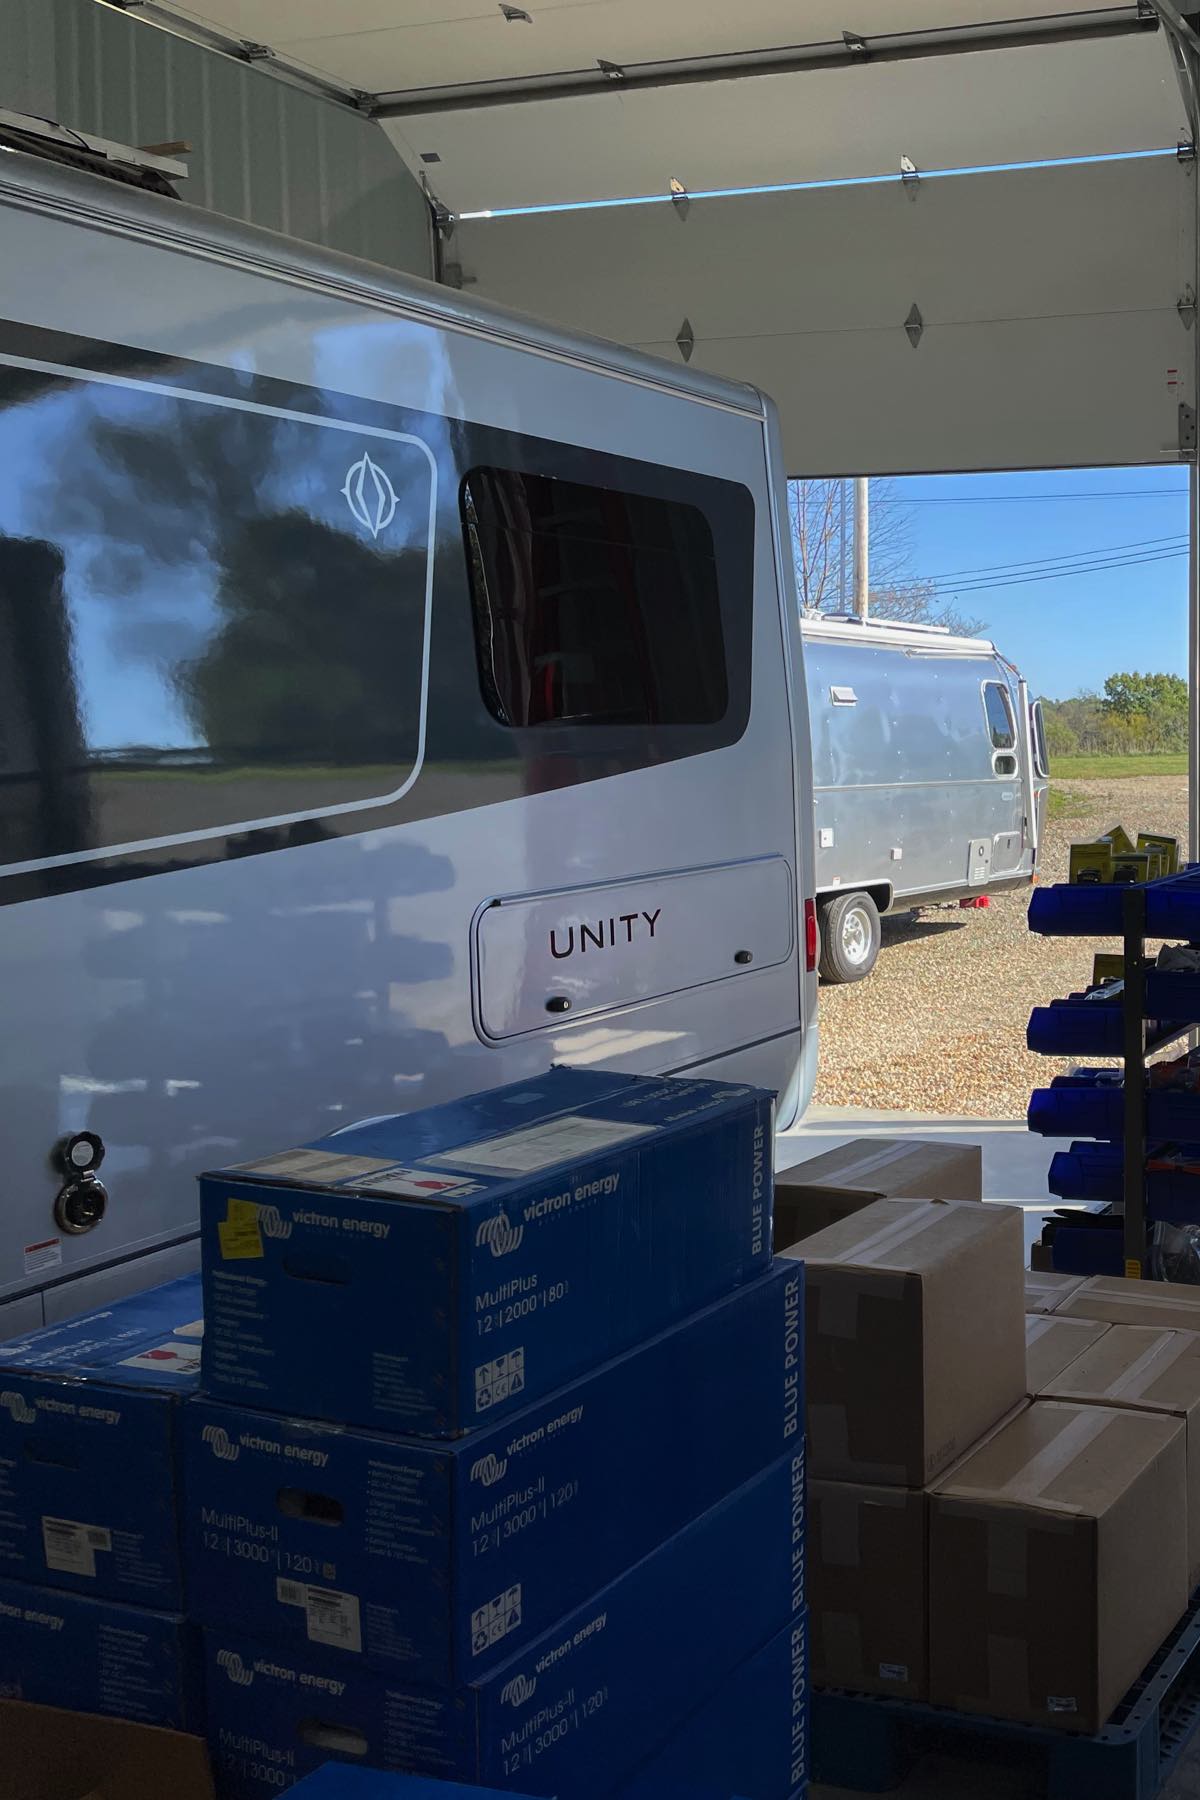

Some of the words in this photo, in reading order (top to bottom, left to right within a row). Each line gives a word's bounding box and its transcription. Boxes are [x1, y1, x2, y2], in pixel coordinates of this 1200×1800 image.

[550, 908, 661, 959] UNITY
[752, 1123, 765, 1201] POWER
[292, 1208, 338, 1230] victron
[342, 1218, 391, 1239] energy
[523, 1192, 571, 1222] victron
[574, 1172, 620, 1201] energy
[751, 1203, 763, 1256] BLUE
[475, 1274, 538, 1313] MultiPlus
[784, 1274, 799, 1371] POWER
[78, 1405, 121, 1425] energy
[506, 1426, 544, 1456] victron
[546, 1404, 584, 1433] energy
[783, 1371, 799, 1440] BLUE
[239, 1432, 281, 1454] victron
[284, 1443, 329, 1468] energy
[471, 1475, 545, 1534] MultiPlus-II
[791, 1450, 805, 1545] POWER
[201, 1507, 279, 1542] MultiPlus-II
[791, 1543, 804, 1613] BLUE
[24, 1610, 65, 1631] energy
[535, 1640, 572, 1674] victron
[573, 1612, 607, 1645] energy
[253, 1661, 296, 1682] victron
[299, 1671, 346, 1696] energy
[791, 1622, 806, 1718] POWER
[500, 1688, 575, 1755] MultiPlus-II
[791, 1715, 805, 1785] BLUE
